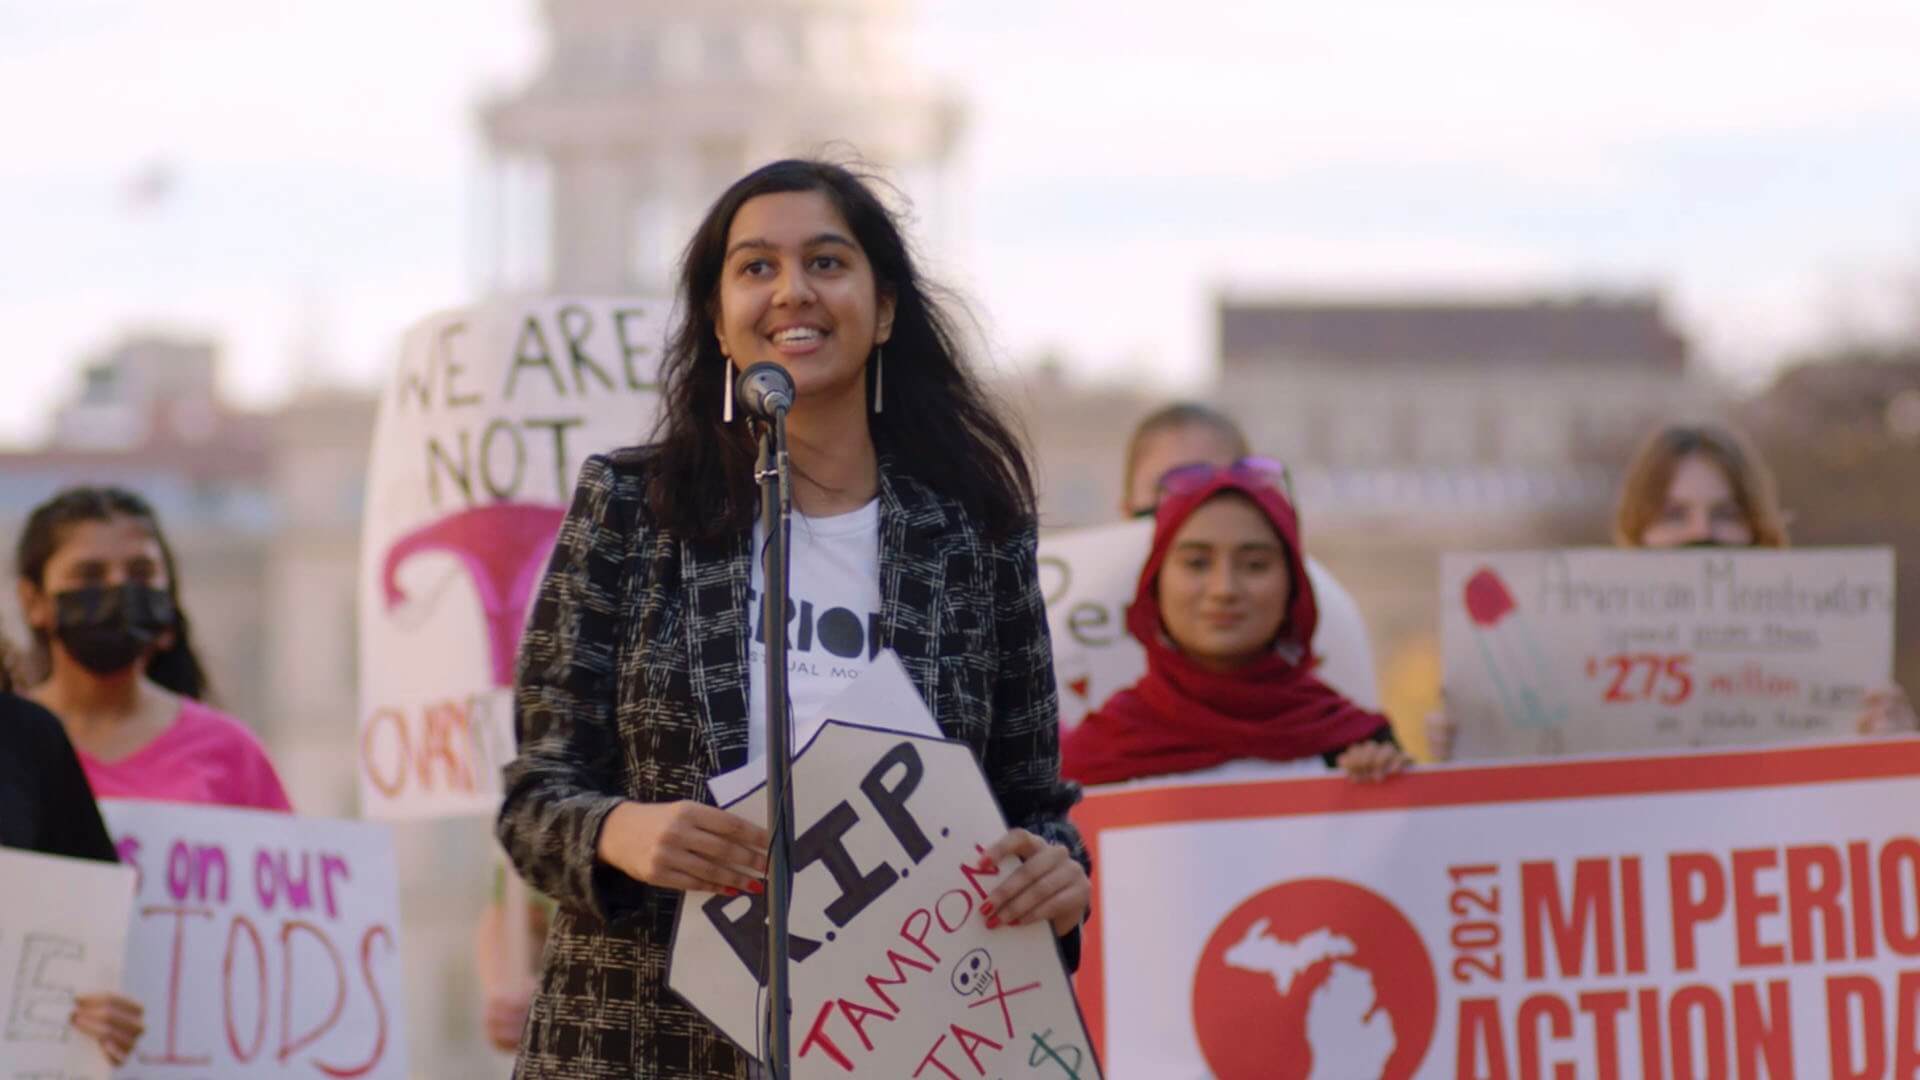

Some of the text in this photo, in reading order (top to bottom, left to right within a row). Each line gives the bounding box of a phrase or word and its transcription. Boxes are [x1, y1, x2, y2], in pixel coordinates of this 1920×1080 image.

[397, 304, 660, 412] WE ARE
[427, 417, 586, 506] NOT
[166, 839, 230, 903] on
[254, 848, 354, 918] our
[1447, 864, 1502, 984] 2021
[1519, 855, 1648, 980] MI
[799, 844, 1000, 1071] TAMPON
[912, 970, 1042, 1080] TAX
[1455, 979, 1795, 1080] ACTION
